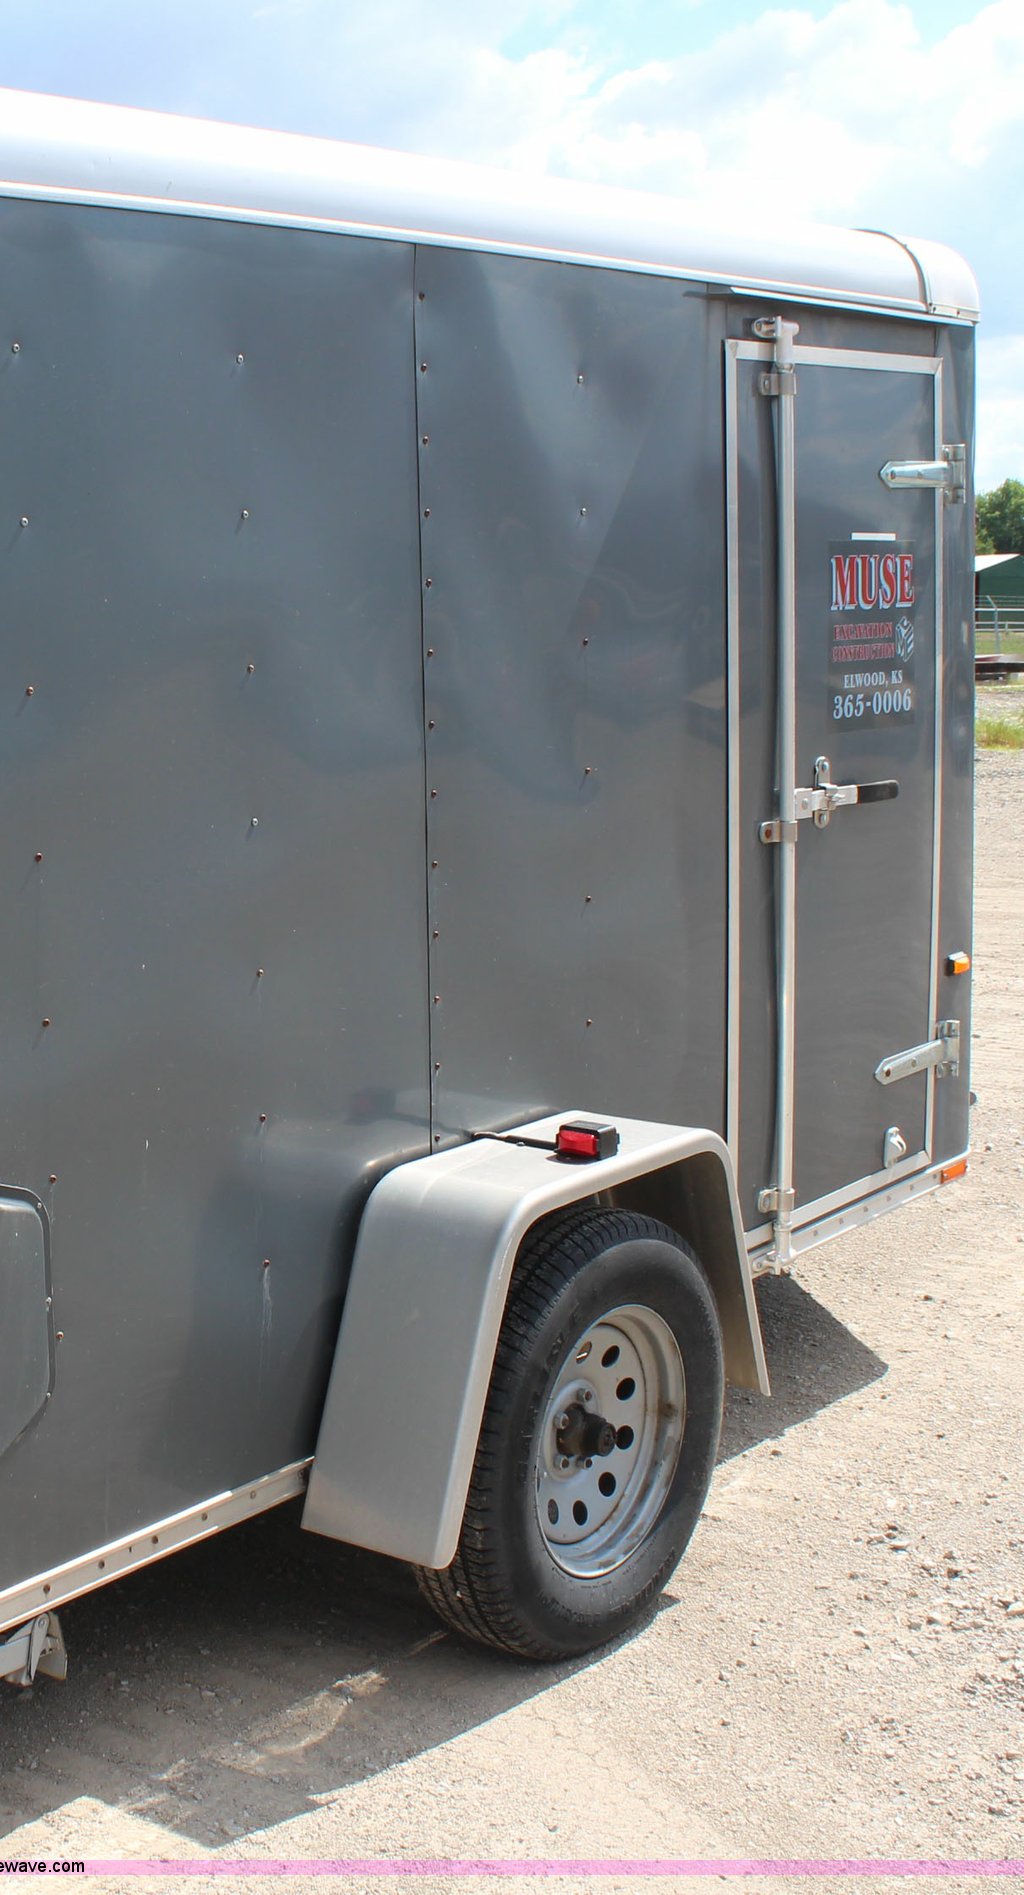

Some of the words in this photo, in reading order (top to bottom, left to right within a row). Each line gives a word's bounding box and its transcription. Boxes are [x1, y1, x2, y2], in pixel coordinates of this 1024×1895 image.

[830, 553, 915, 611] MUSE
[833, 622, 893, 641] EXCAVATION
[843, 671, 889, 689] ELWOOD,
[891, 670, 903, 684] KS
[833, 688, 912, 720] 365-0006
